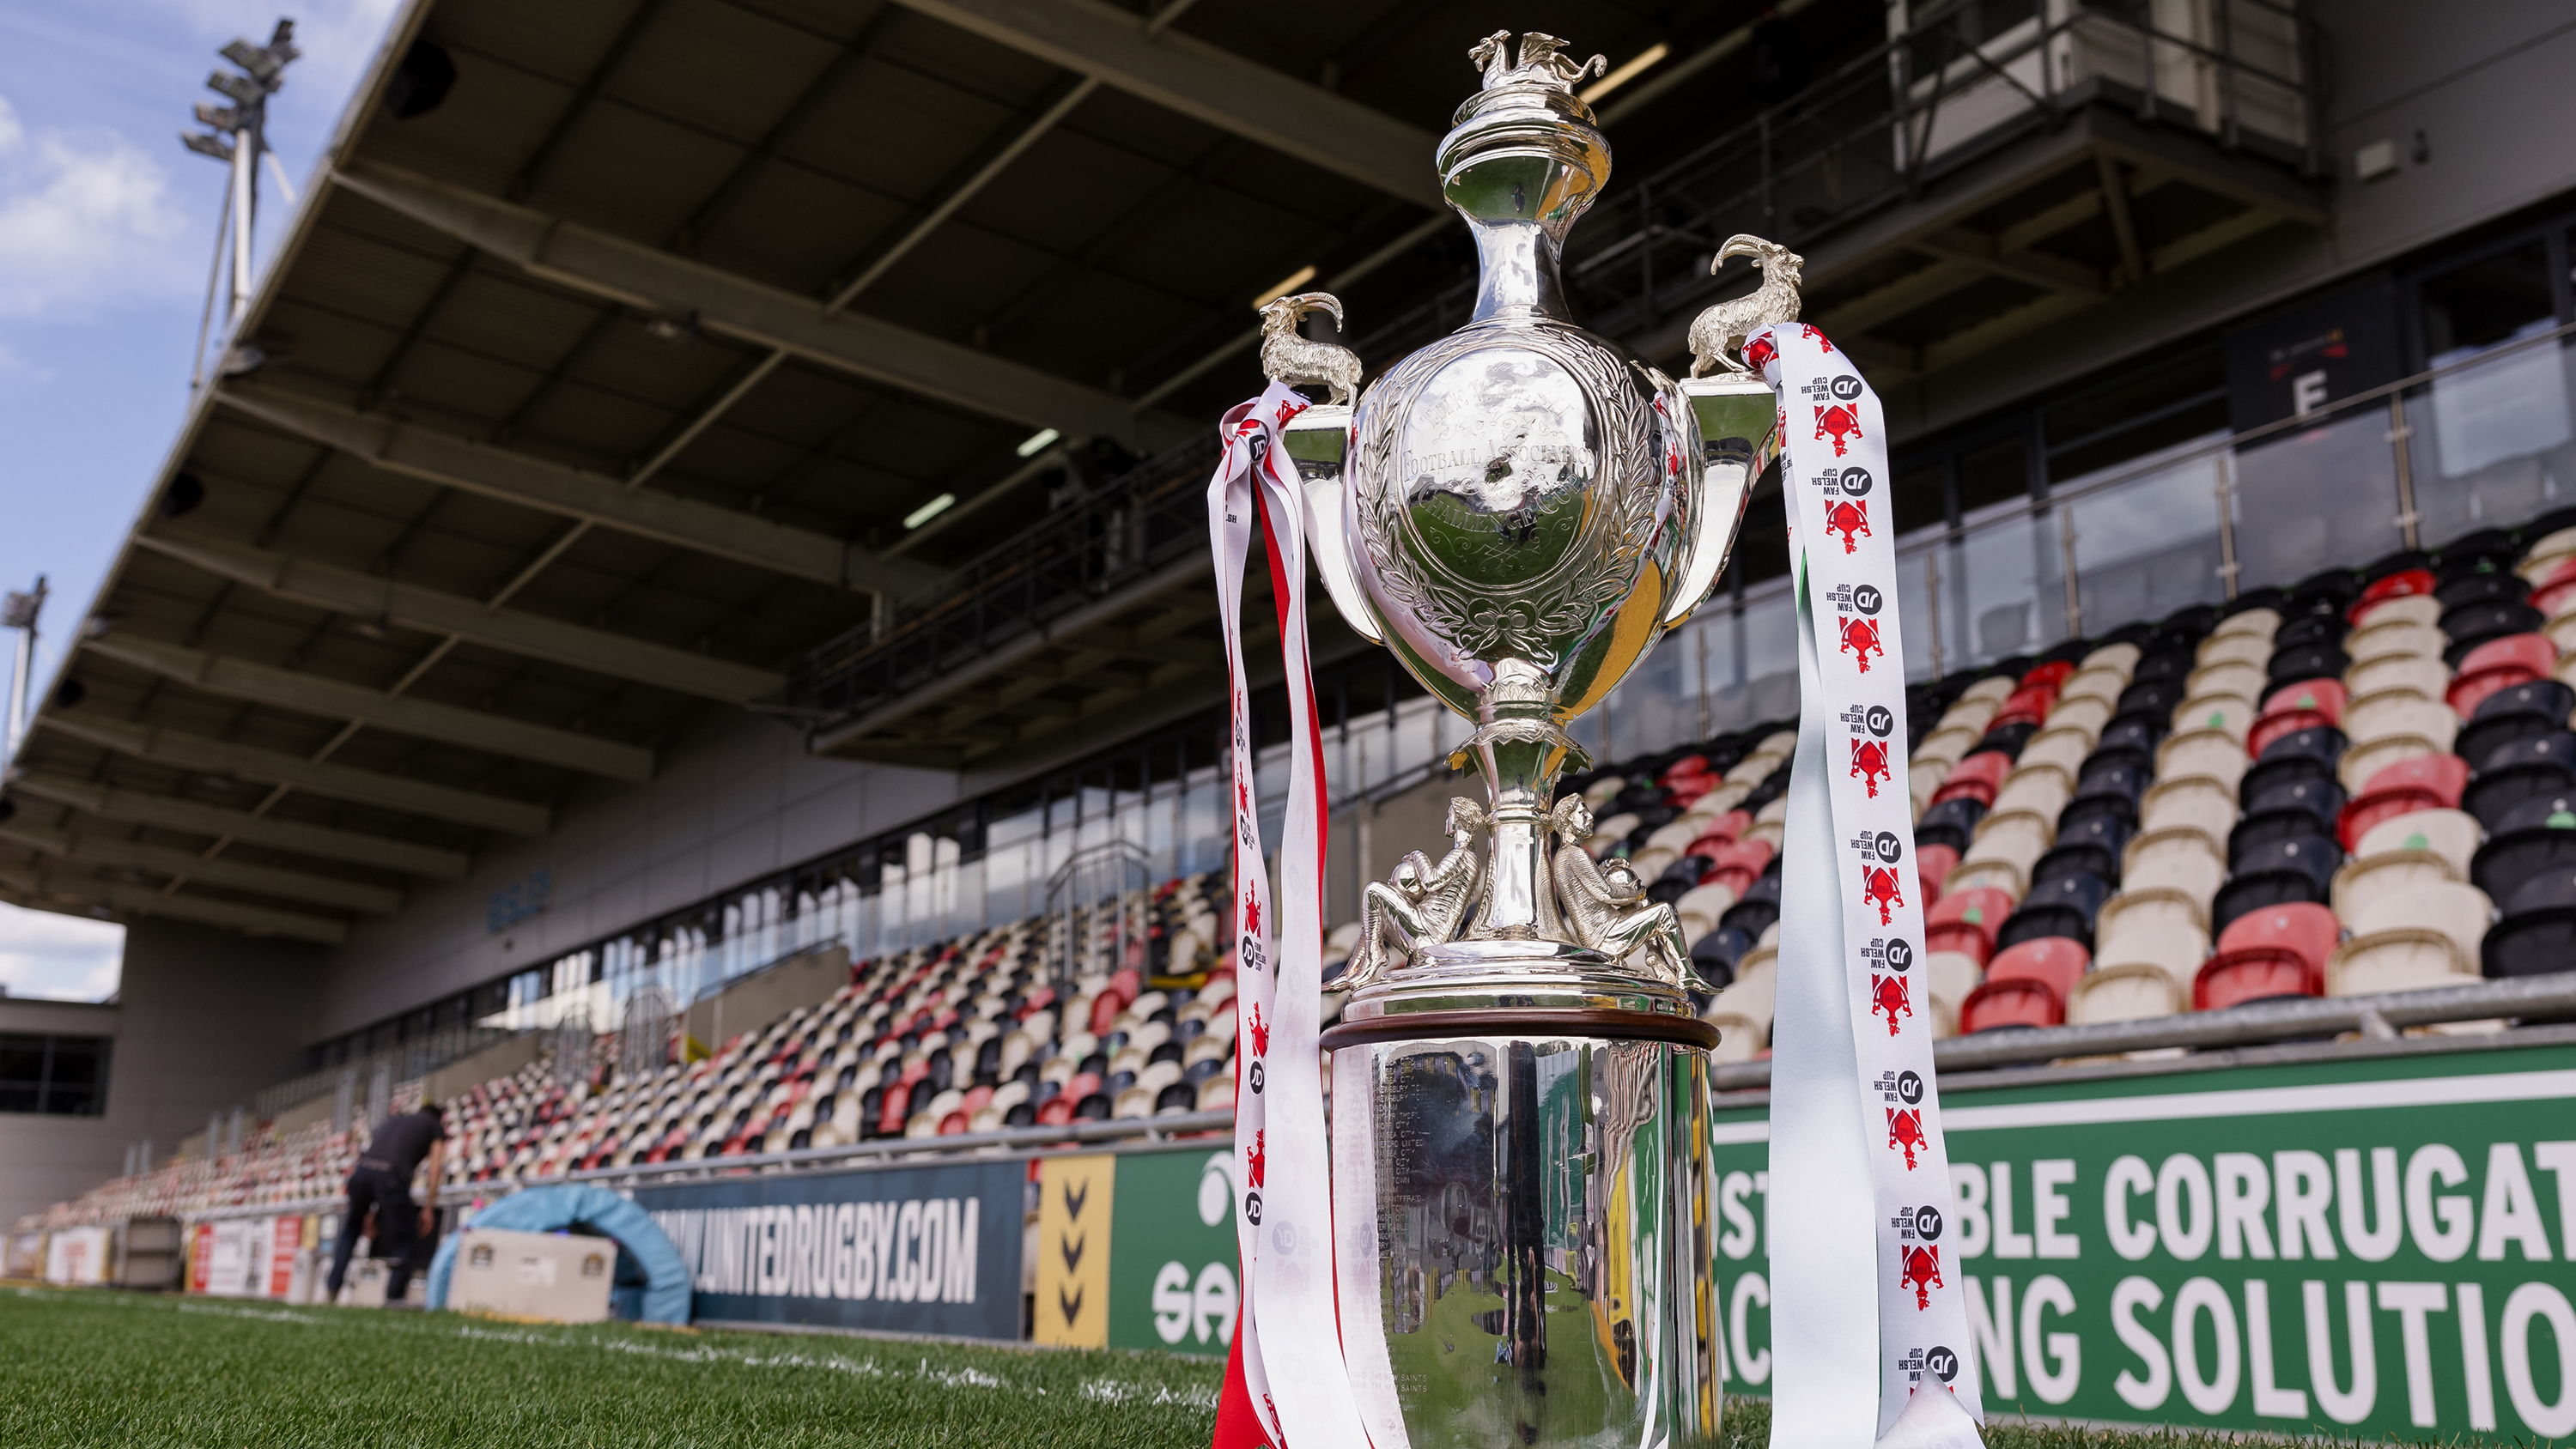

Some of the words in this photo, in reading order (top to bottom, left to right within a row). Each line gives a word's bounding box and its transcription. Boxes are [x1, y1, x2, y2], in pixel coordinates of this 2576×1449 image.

[1801, 385, 1828, 394] WELSH
[1835, 381, 1857, 394] JD
[1420, 390, 1469, 427] THE
[1403, 448, 1481, 482] FOOTBALL
[1844, 474, 1868, 489] JD
[1419, 482, 1538, 533] CHALLENGE
[1535, 473, 1581, 514] CUP
[1837, 584, 1850, 592] CUP
[1826, 592, 1852, 602] WELSH
[1857, 592, 1878, 608] JD
[1838, 603, 1852, 611] FAW
[1850, 705, 1863, 713] CUP
[1840, 713, 1864, 724] WELSH
[1869, 713, 1889, 730] JD
[1850, 724, 1865, 733] FAW
[1860, 831, 1872, 840] CUP
[1850, 840, 1874, 850] WELSH
[1879, 840, 1898, 856] JD
[1862, 851, 1875, 860] FAW
[1871, 938, 1883, 947] CUP
[1244, 943, 1253, 960] JD
[1861, 948, 1884, 958] WELSH
[1889, 947, 1908, 963] JD
[1871, 960, 1885, 968] FAW
[1251, 1069, 1263, 1087] JD
[1883, 1071, 1895, 1080] CUP
[1874, 1081, 1897, 1091] WELSH
[1901, 1079, 1919, 1096] JD
[1885, 1093, 1898, 1101] FAW
[2104, 1141, 2576, 1263] CORRUGAT
[1249, 1199, 1261, 1218] JD
[1901, 1207, 1912, 1216] CUP
[1892, 1218, 1914, 1228] WELSH
[1919, 1215, 1938, 1232] JD
[1901, 1229, 1915, 1239] FAW
[1909, 1349, 1923, 1358] CUP
[2111, 1276, 2576, 1440] SOLUTIO
[1899, 1361, 1923, 1370] WELSH
[1930, 1355, 1953, 1373] JD
[1909, 1372, 1924, 1381] AW
